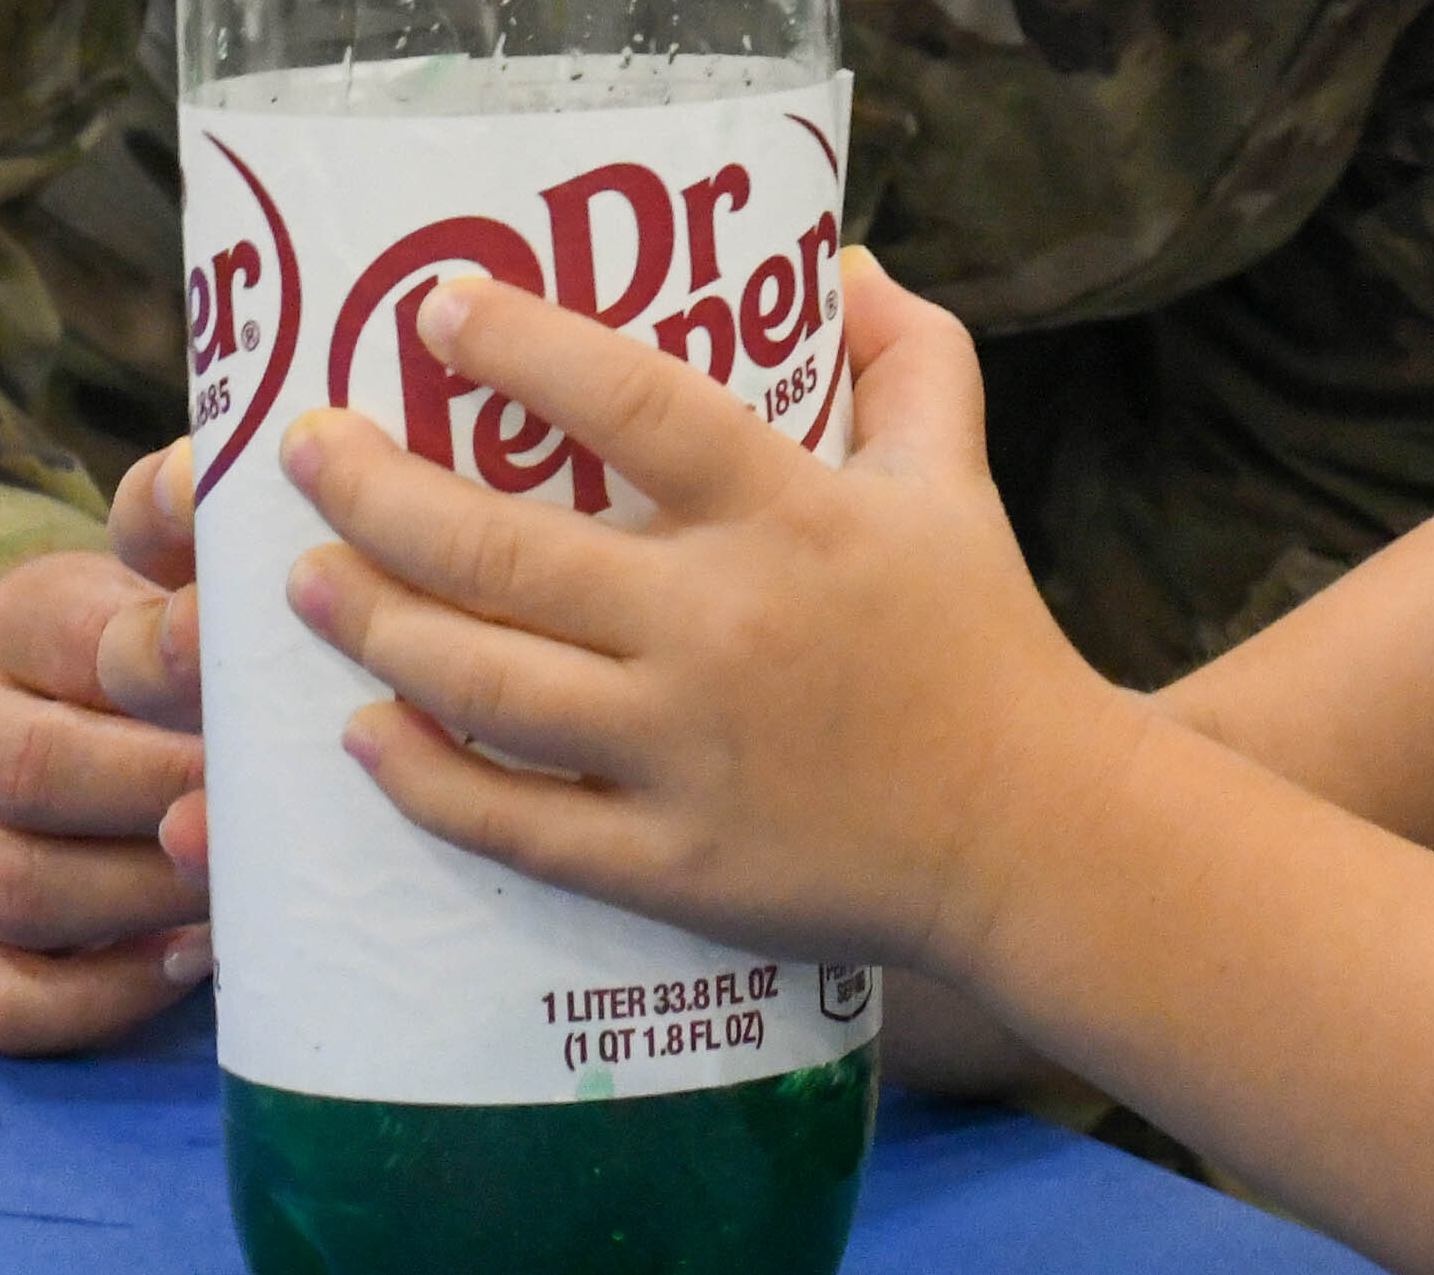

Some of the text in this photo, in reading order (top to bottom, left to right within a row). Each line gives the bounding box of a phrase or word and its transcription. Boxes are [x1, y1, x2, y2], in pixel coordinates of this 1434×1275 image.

[540, 162, 750, 329] Dr
[765, 354, 818, 423] 1885
[541, 965, 778, 1024] 1 LITER 33.8 FL OZ
[564, 1010, 765, 1071] (1 QT 1.8 FL OZ)
